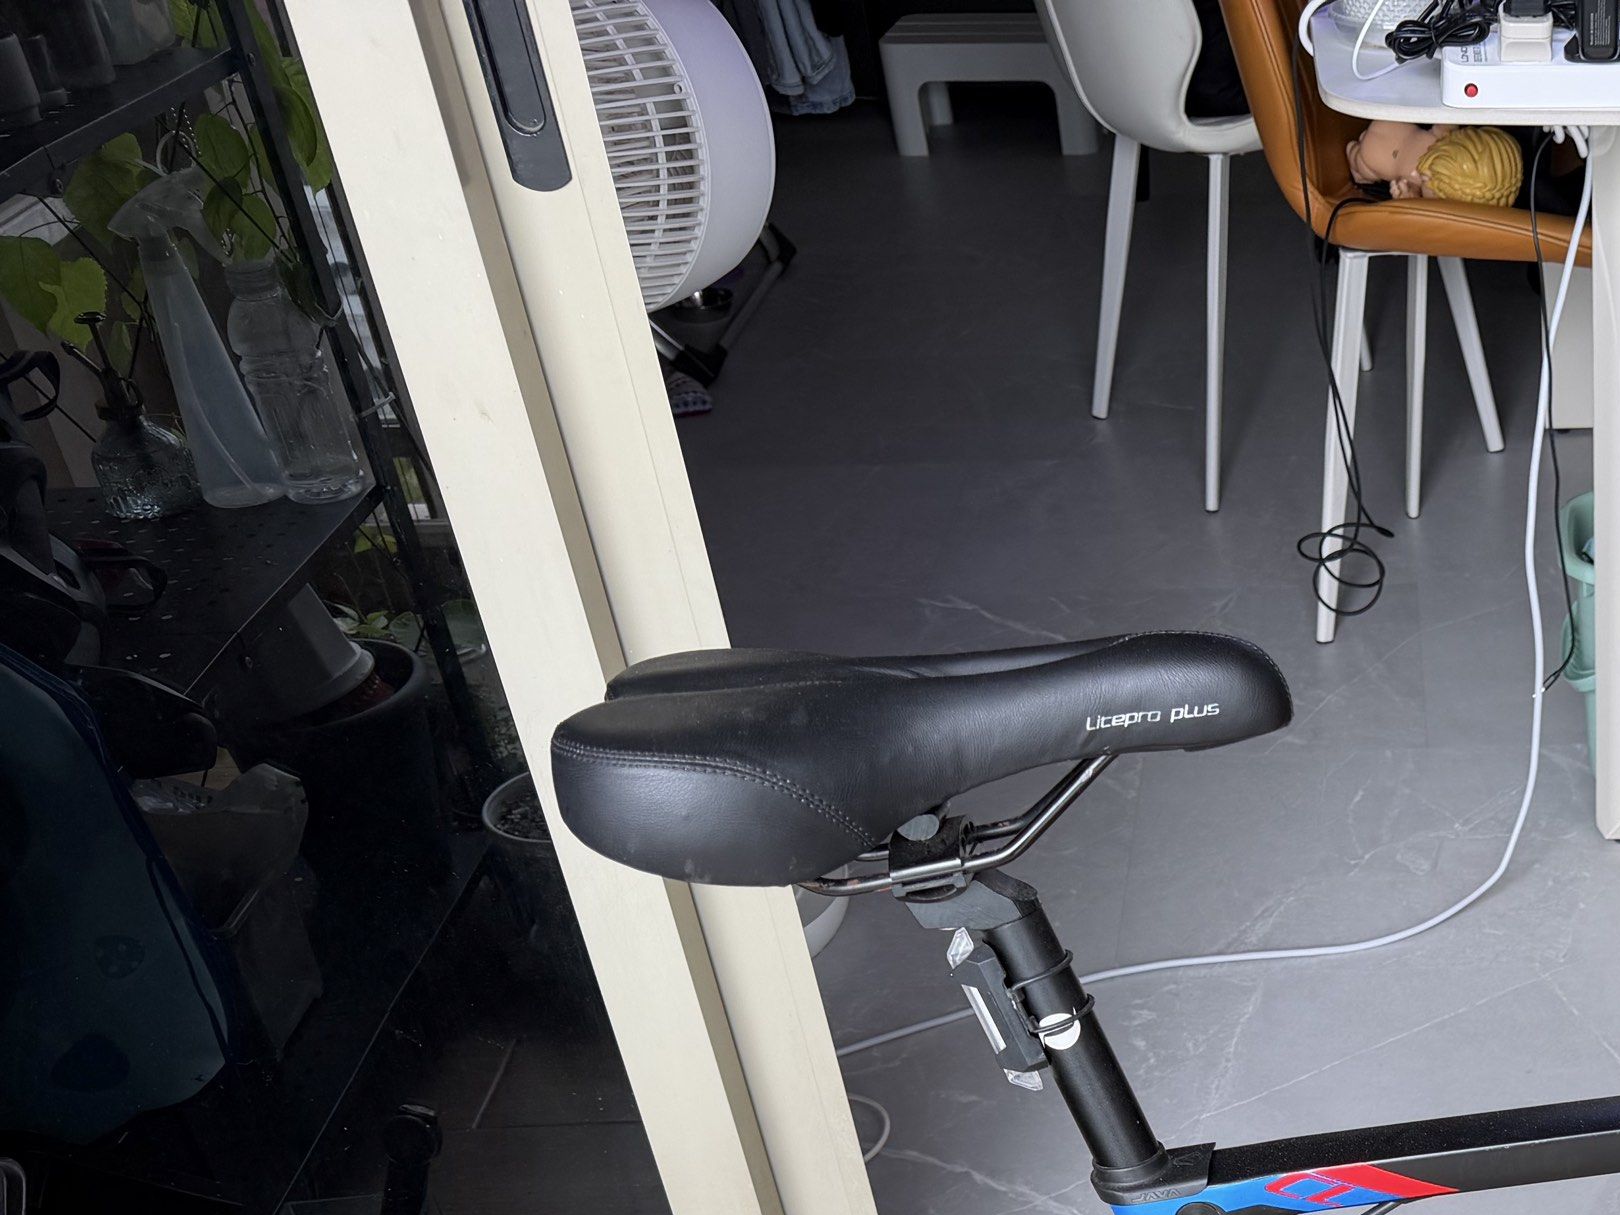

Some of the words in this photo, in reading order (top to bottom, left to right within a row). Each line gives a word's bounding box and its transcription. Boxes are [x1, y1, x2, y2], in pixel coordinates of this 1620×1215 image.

[1085, 710, 1162, 732] Litepro
[1169, 702, 1221, 724] plus
[1129, 1187, 1181, 1204] JAVA
